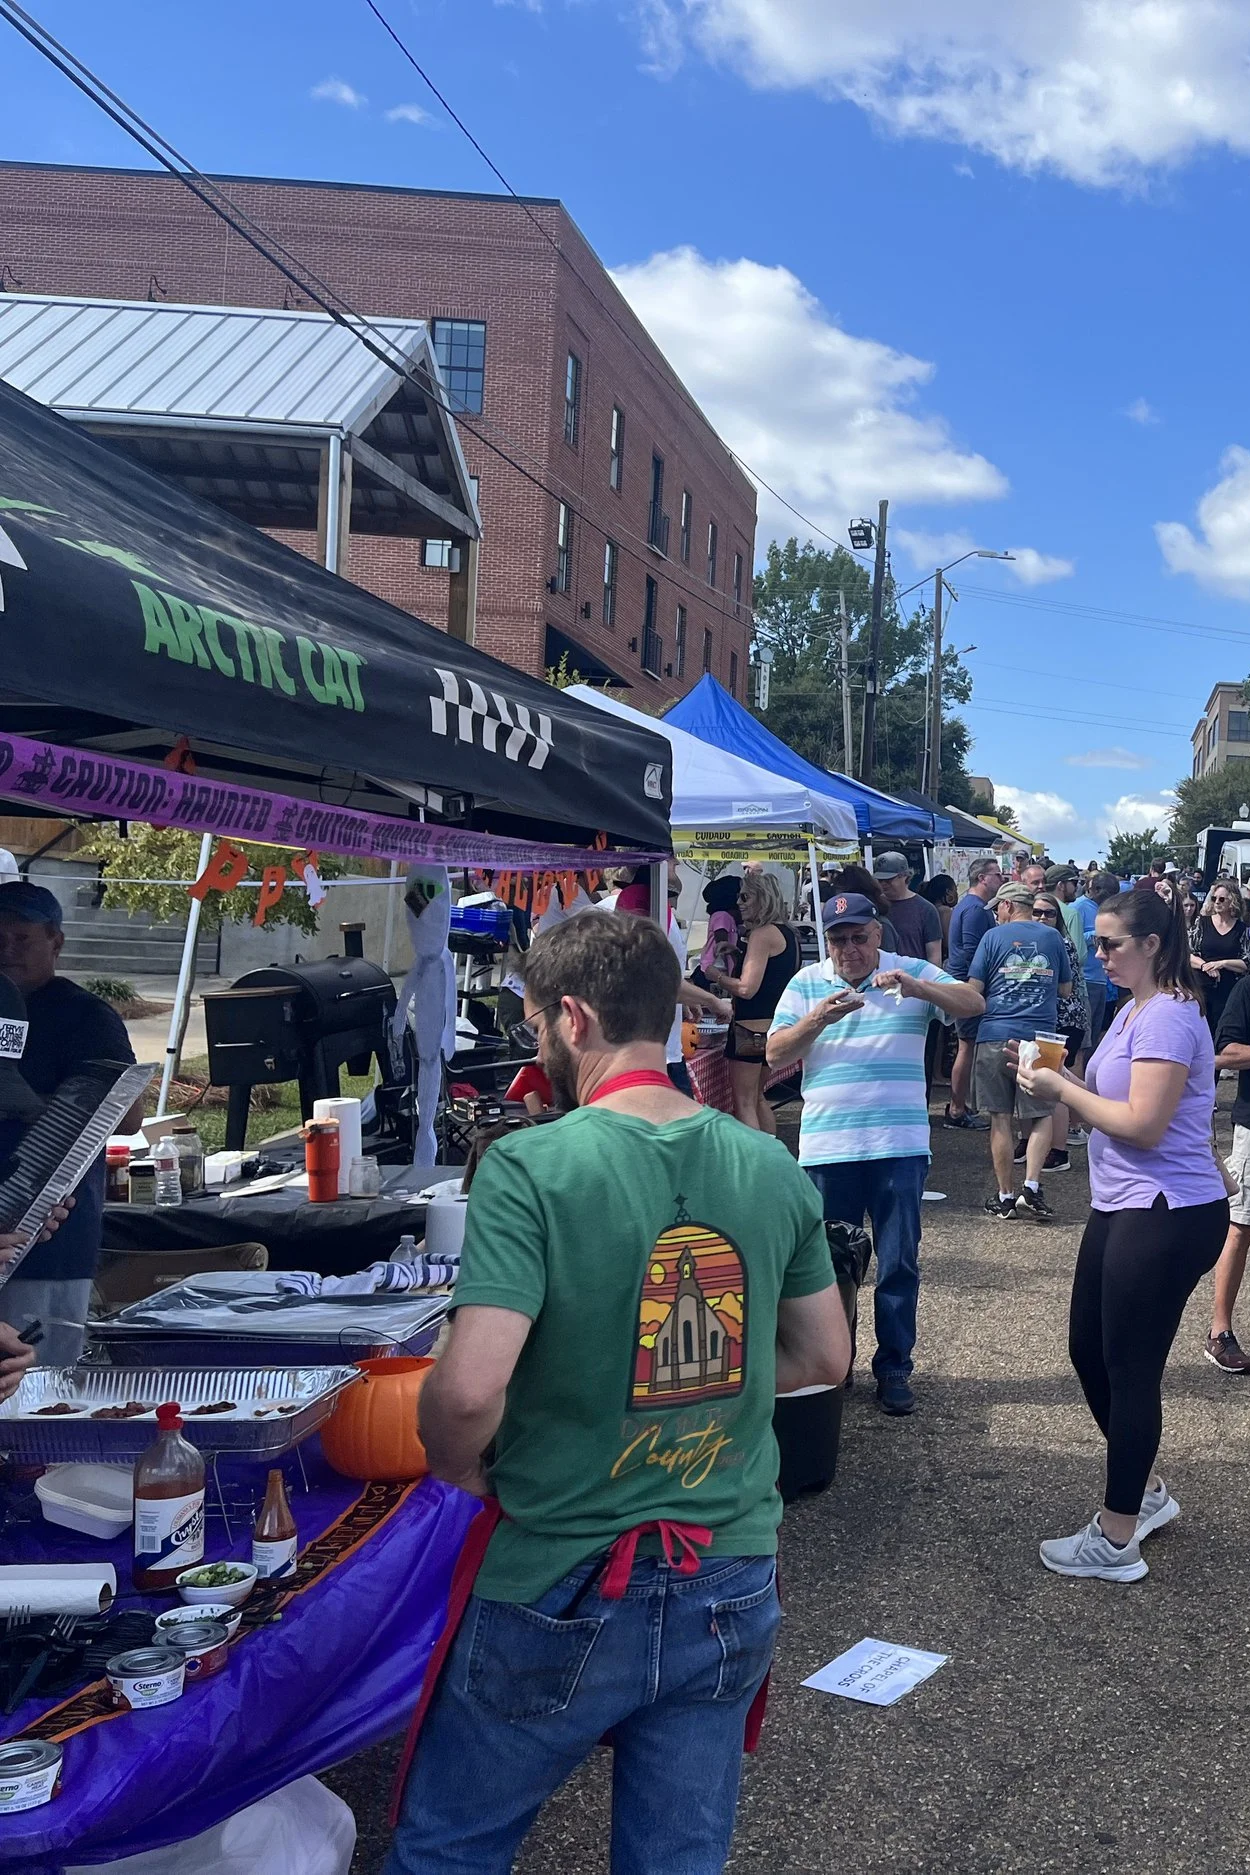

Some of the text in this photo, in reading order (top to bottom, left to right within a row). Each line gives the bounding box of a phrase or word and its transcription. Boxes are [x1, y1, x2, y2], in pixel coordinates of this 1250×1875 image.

[130, 579, 366, 713] ARCTIC CAT
[169, 781, 275, 832] HAUNTED
[695, 831, 802, 841] CUIDADO CAUTION
[138, 1681, 162, 1690] Sterno
[838, 1652, 893, 1688] THE CROSS
[859, 1656, 911, 1694] CHAPEL OF
[0, 1784, 20, 1792] erno
